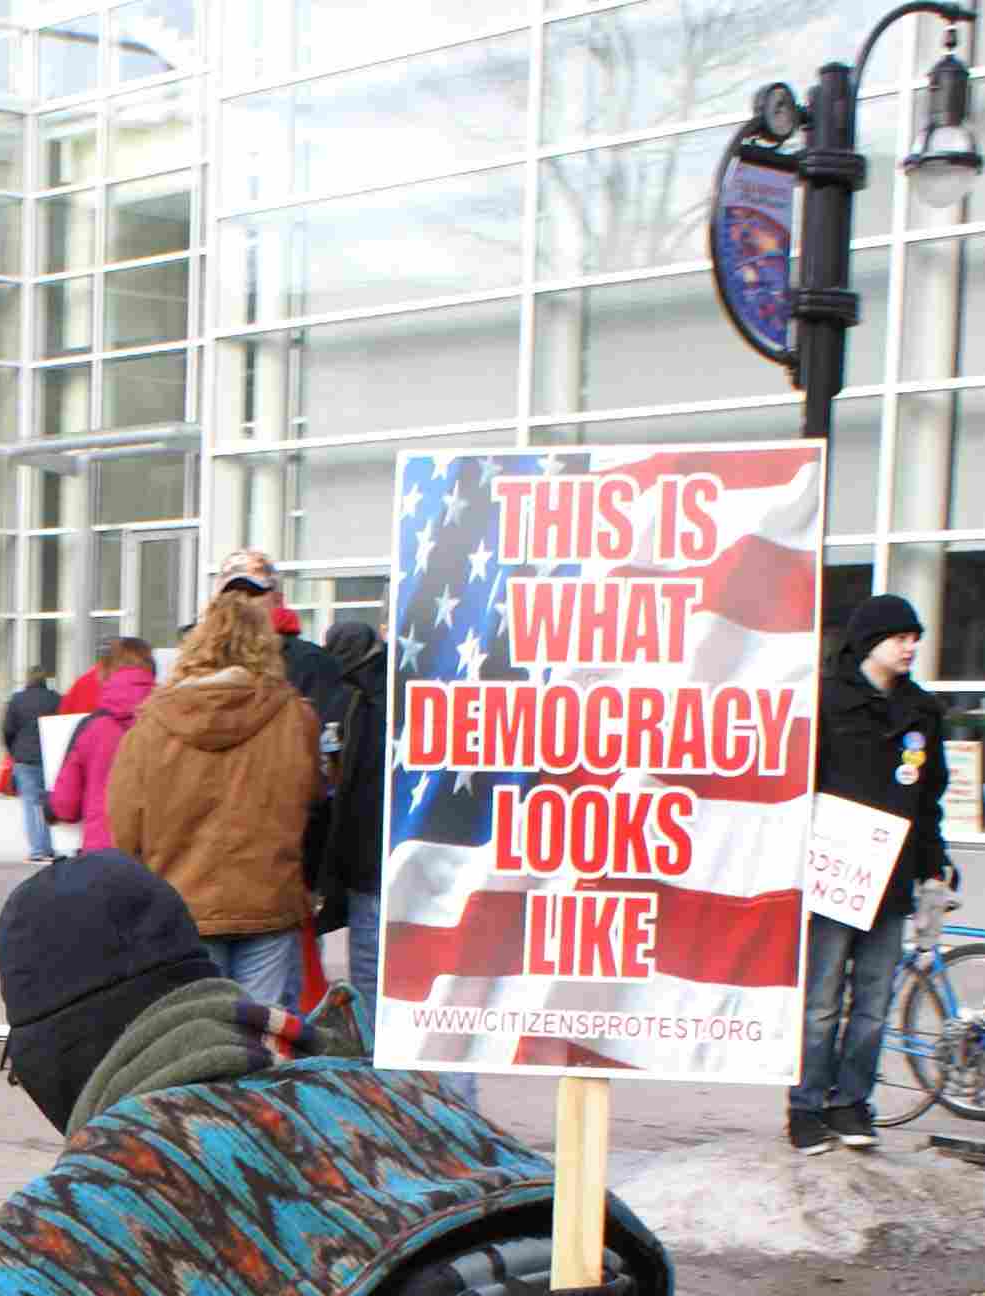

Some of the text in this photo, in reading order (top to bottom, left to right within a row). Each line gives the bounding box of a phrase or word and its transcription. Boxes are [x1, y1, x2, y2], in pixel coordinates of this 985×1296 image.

[493, 476, 722, 564] THIS IS
[510, 580, 700, 666] WHAT
[404, 683, 796, 772] DEMOCRACY
[492, 786, 696, 876] LOOKS
[525, 893, 655, 981] LIKE
[411, 1005, 764, 1043] WWW.CITIZENSPROTEST.ORG
